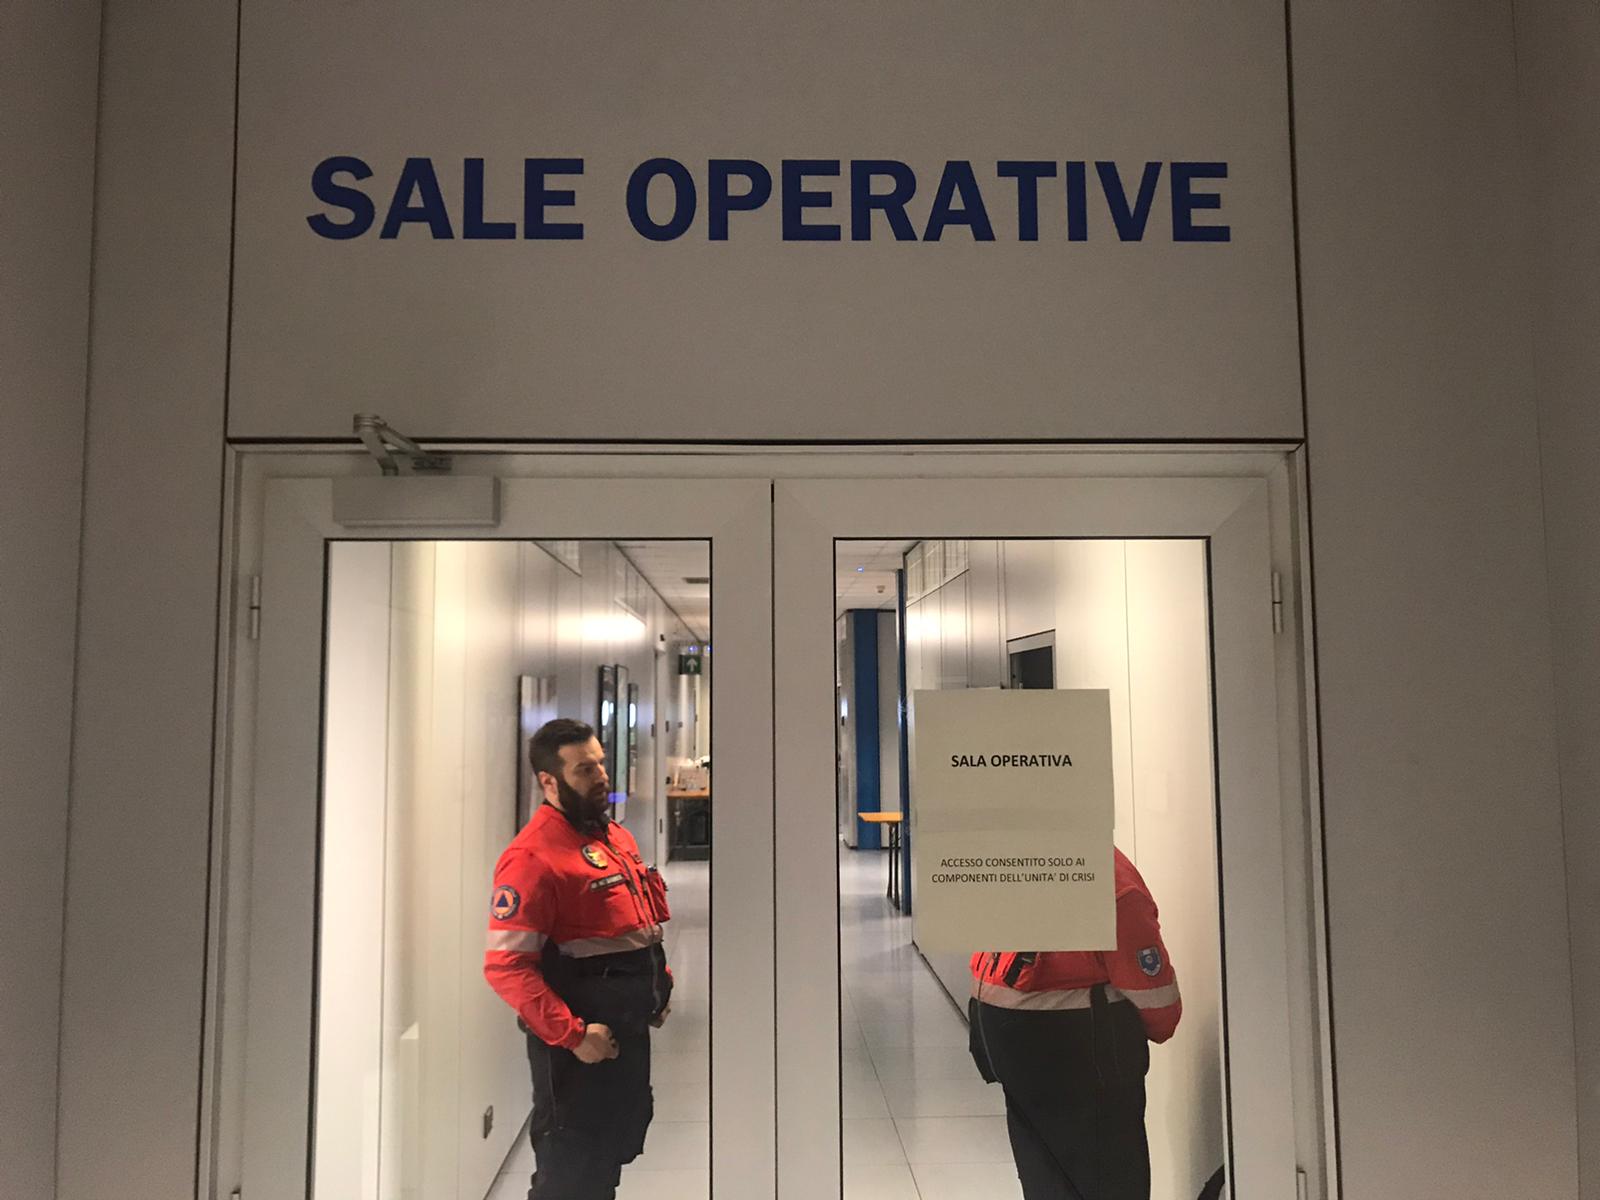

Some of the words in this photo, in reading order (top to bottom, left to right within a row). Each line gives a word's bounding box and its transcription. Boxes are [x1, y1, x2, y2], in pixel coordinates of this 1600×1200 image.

[306, 156, 584, 240] SALE
[626, 158, 1231, 242] OPERATIVE
[951, 755, 987, 768] SALA
[991, 755, 1073, 768] OPERATIVA
[940, 858, 983, 868] ACCESSO
[985, 858, 1046, 868] CONSENTITO
[1048, 858, 1073, 867] SOLO
[1075, 857, 1085, 866] AI
[931, 873, 997, 883] COMPONENTI
[1000, 873, 1057, 883] DELL'UNITA'
[1059, 873, 1069, 882] DI
[1071, 872, 1095, 882] CRISI
